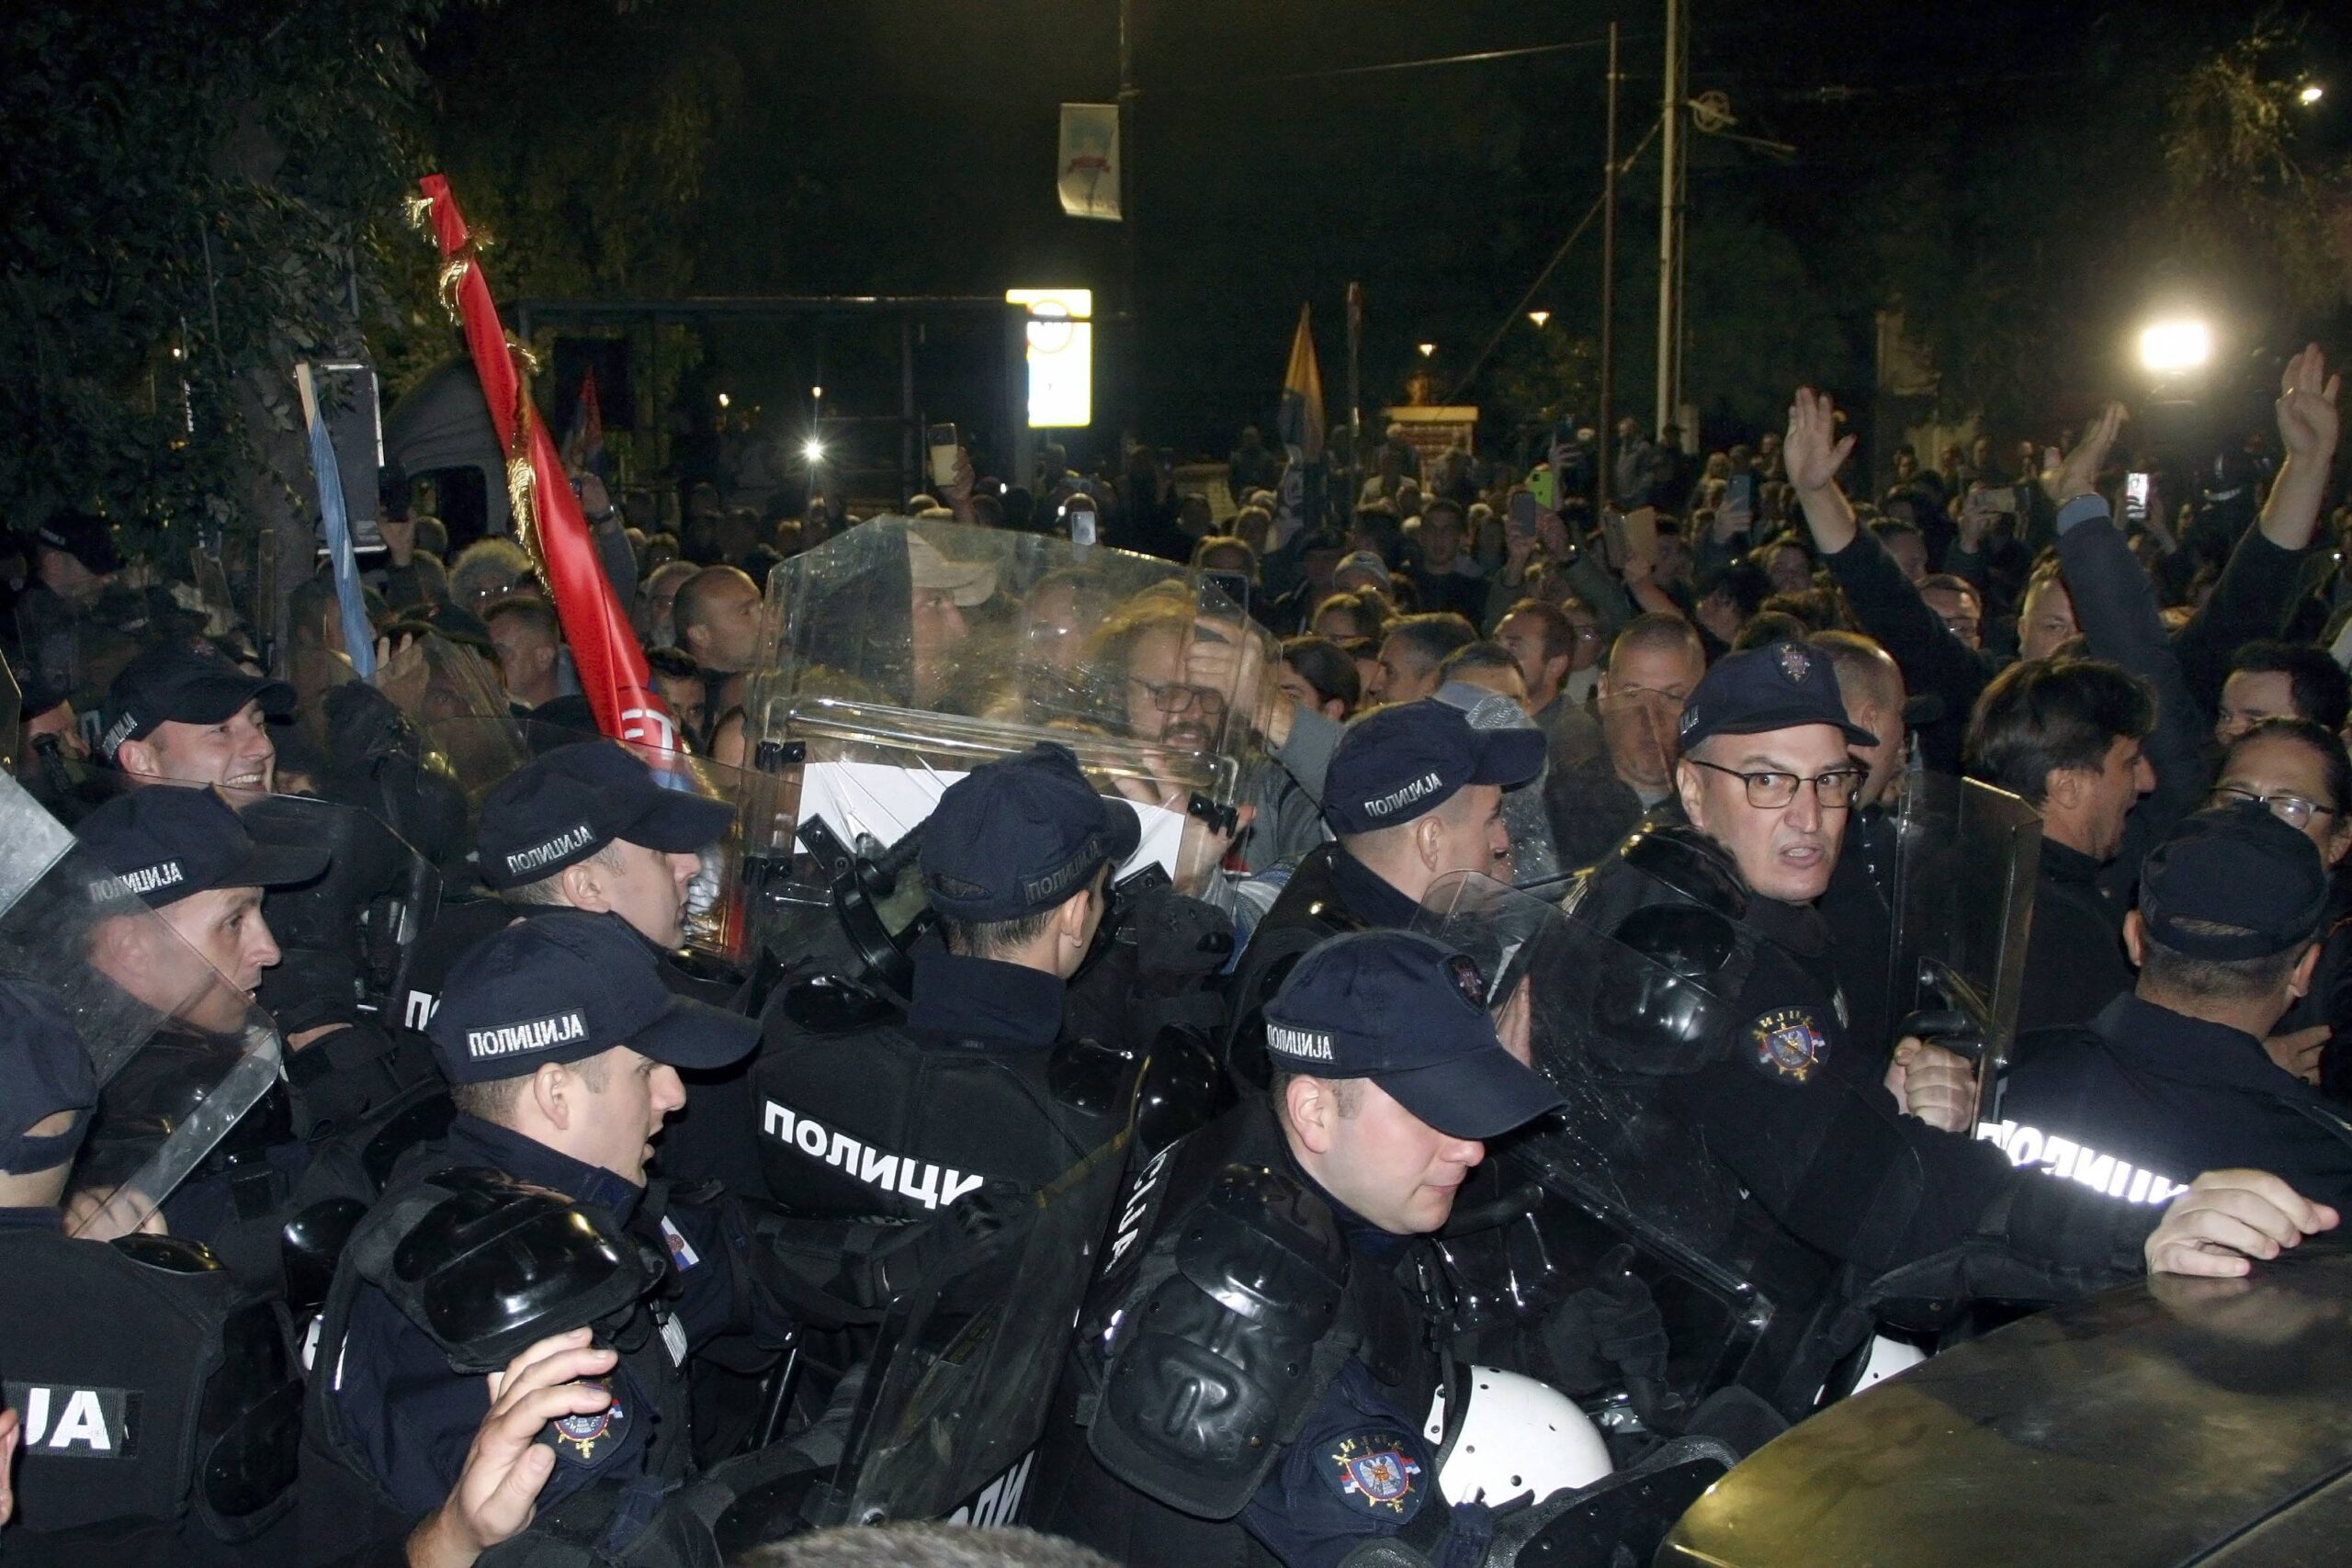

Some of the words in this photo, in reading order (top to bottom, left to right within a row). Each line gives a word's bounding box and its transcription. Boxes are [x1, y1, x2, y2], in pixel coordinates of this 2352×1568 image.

[1363, 773, 1442, 818] ПОЛИЦИЈА
[506, 826, 594, 874] ПОЛИЦИЈА
[88, 862, 184, 903] ПОЛИЦИЈА
[469, 1014, 584, 1057] ПОЛИЦИЈА
[1267, 1023, 1334, 1060] ПОЛИЦИЈА
